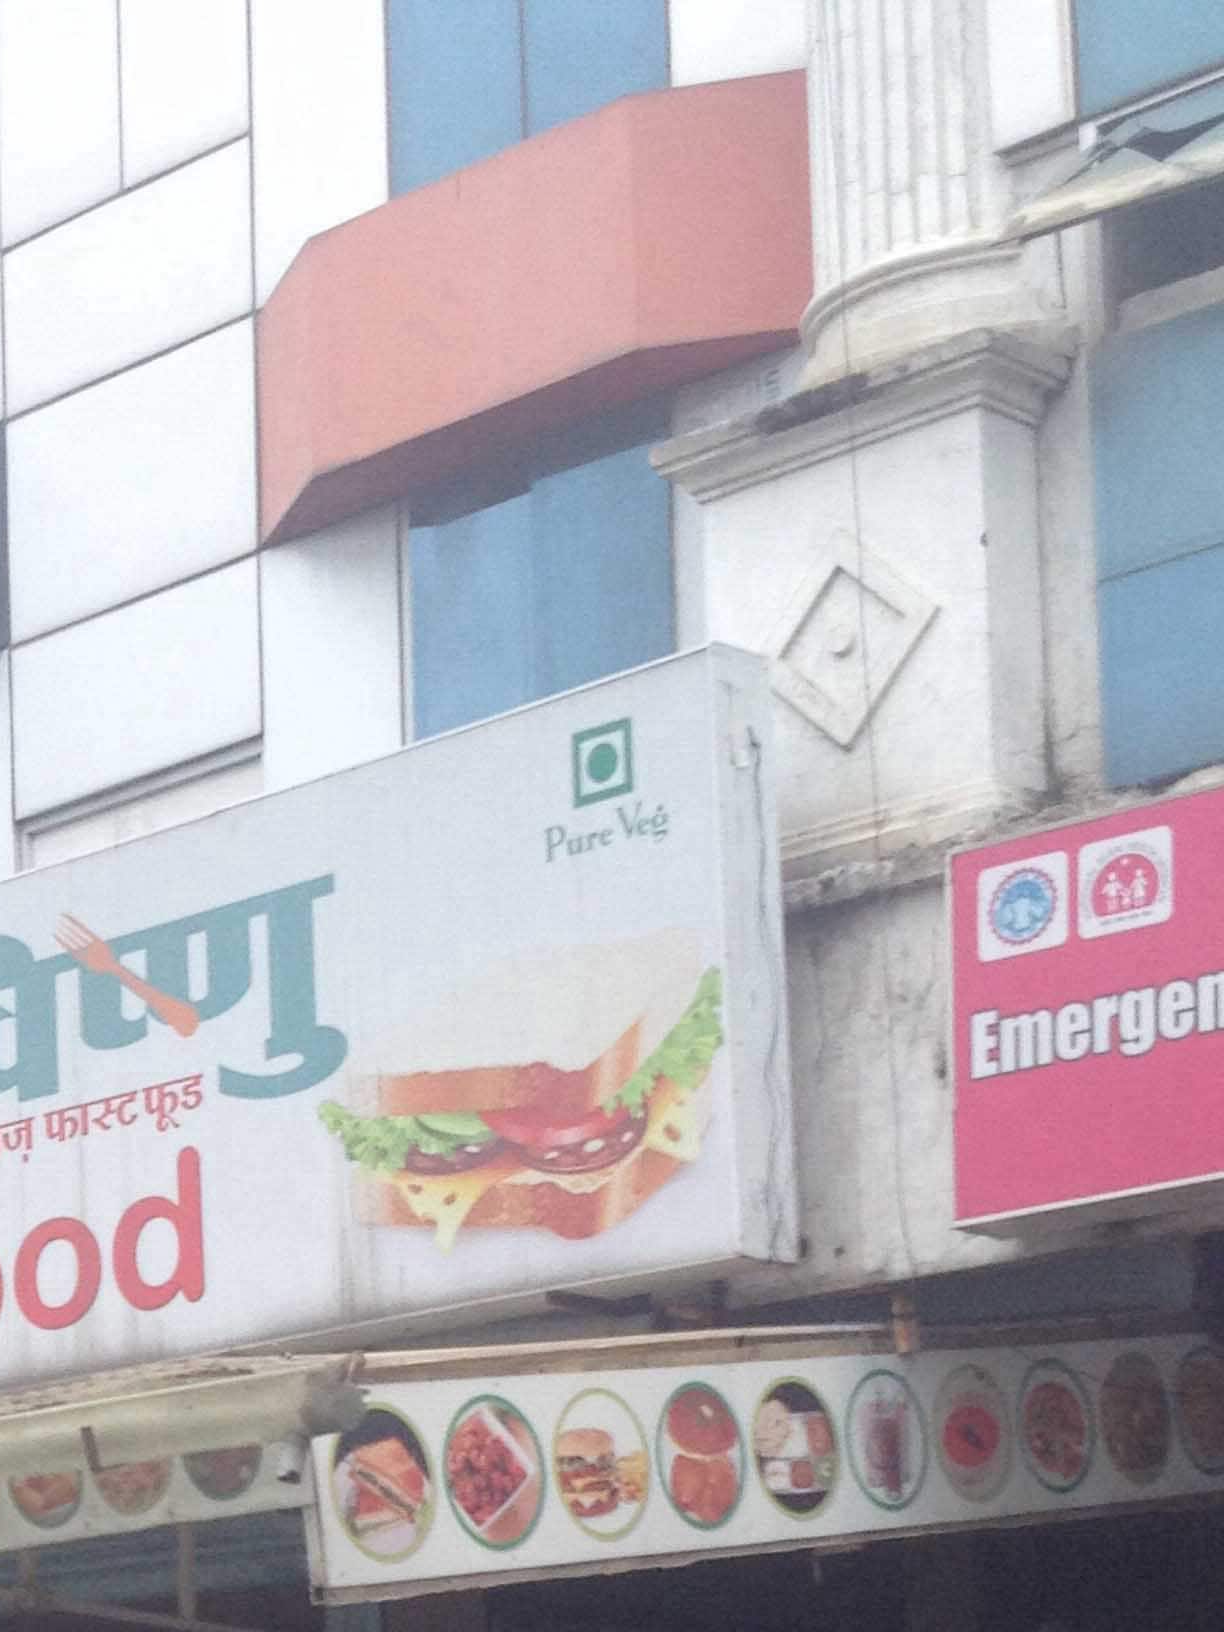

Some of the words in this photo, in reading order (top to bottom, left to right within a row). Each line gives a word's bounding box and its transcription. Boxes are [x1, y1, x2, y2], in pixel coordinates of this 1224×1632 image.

[544, 825, 614, 863] Pure
[616, 800, 670, 844] Veg
[43, 1090, 138, 1142] फास्ट
[141, 1073, 204, 1132] फूड
